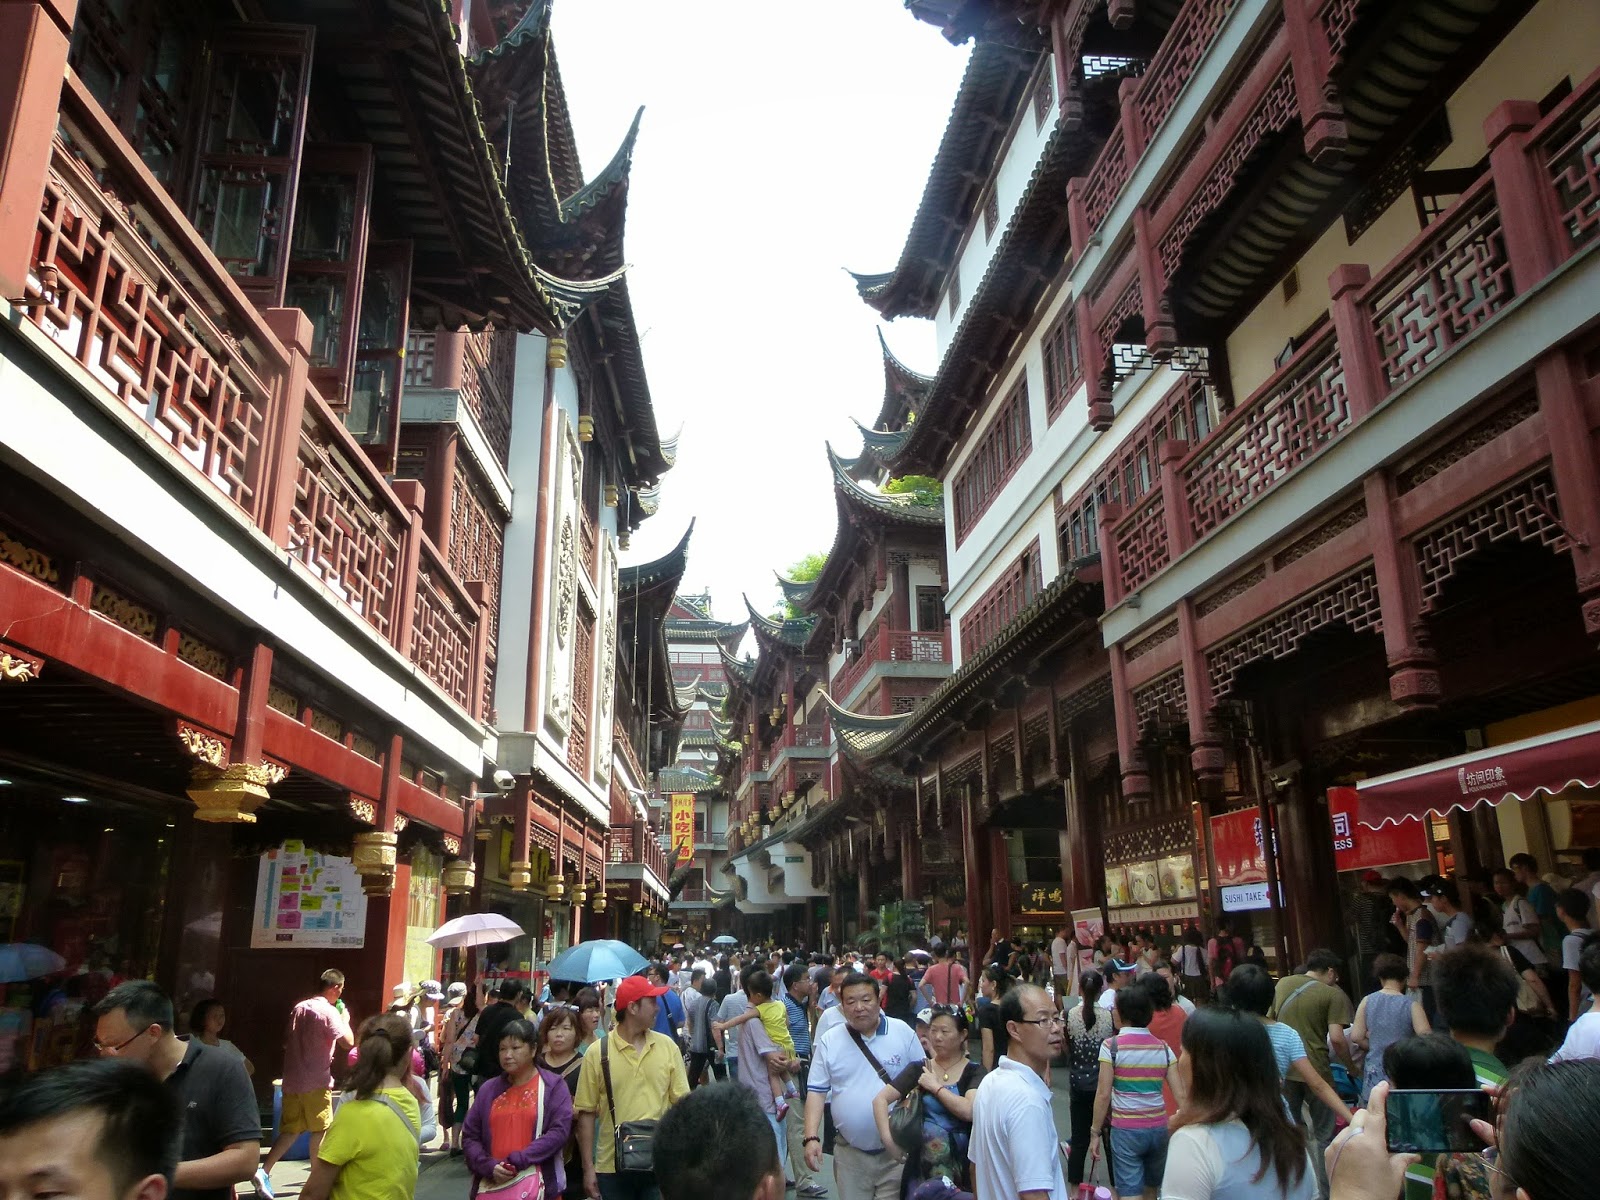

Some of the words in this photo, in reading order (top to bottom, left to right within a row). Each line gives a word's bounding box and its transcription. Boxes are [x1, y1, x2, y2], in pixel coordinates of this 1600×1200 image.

[1466, 766, 1505, 786] 坊间印象
[675, 809, 691, 857] 小吃广场
[1224, 893, 1243, 904] SUSHI
